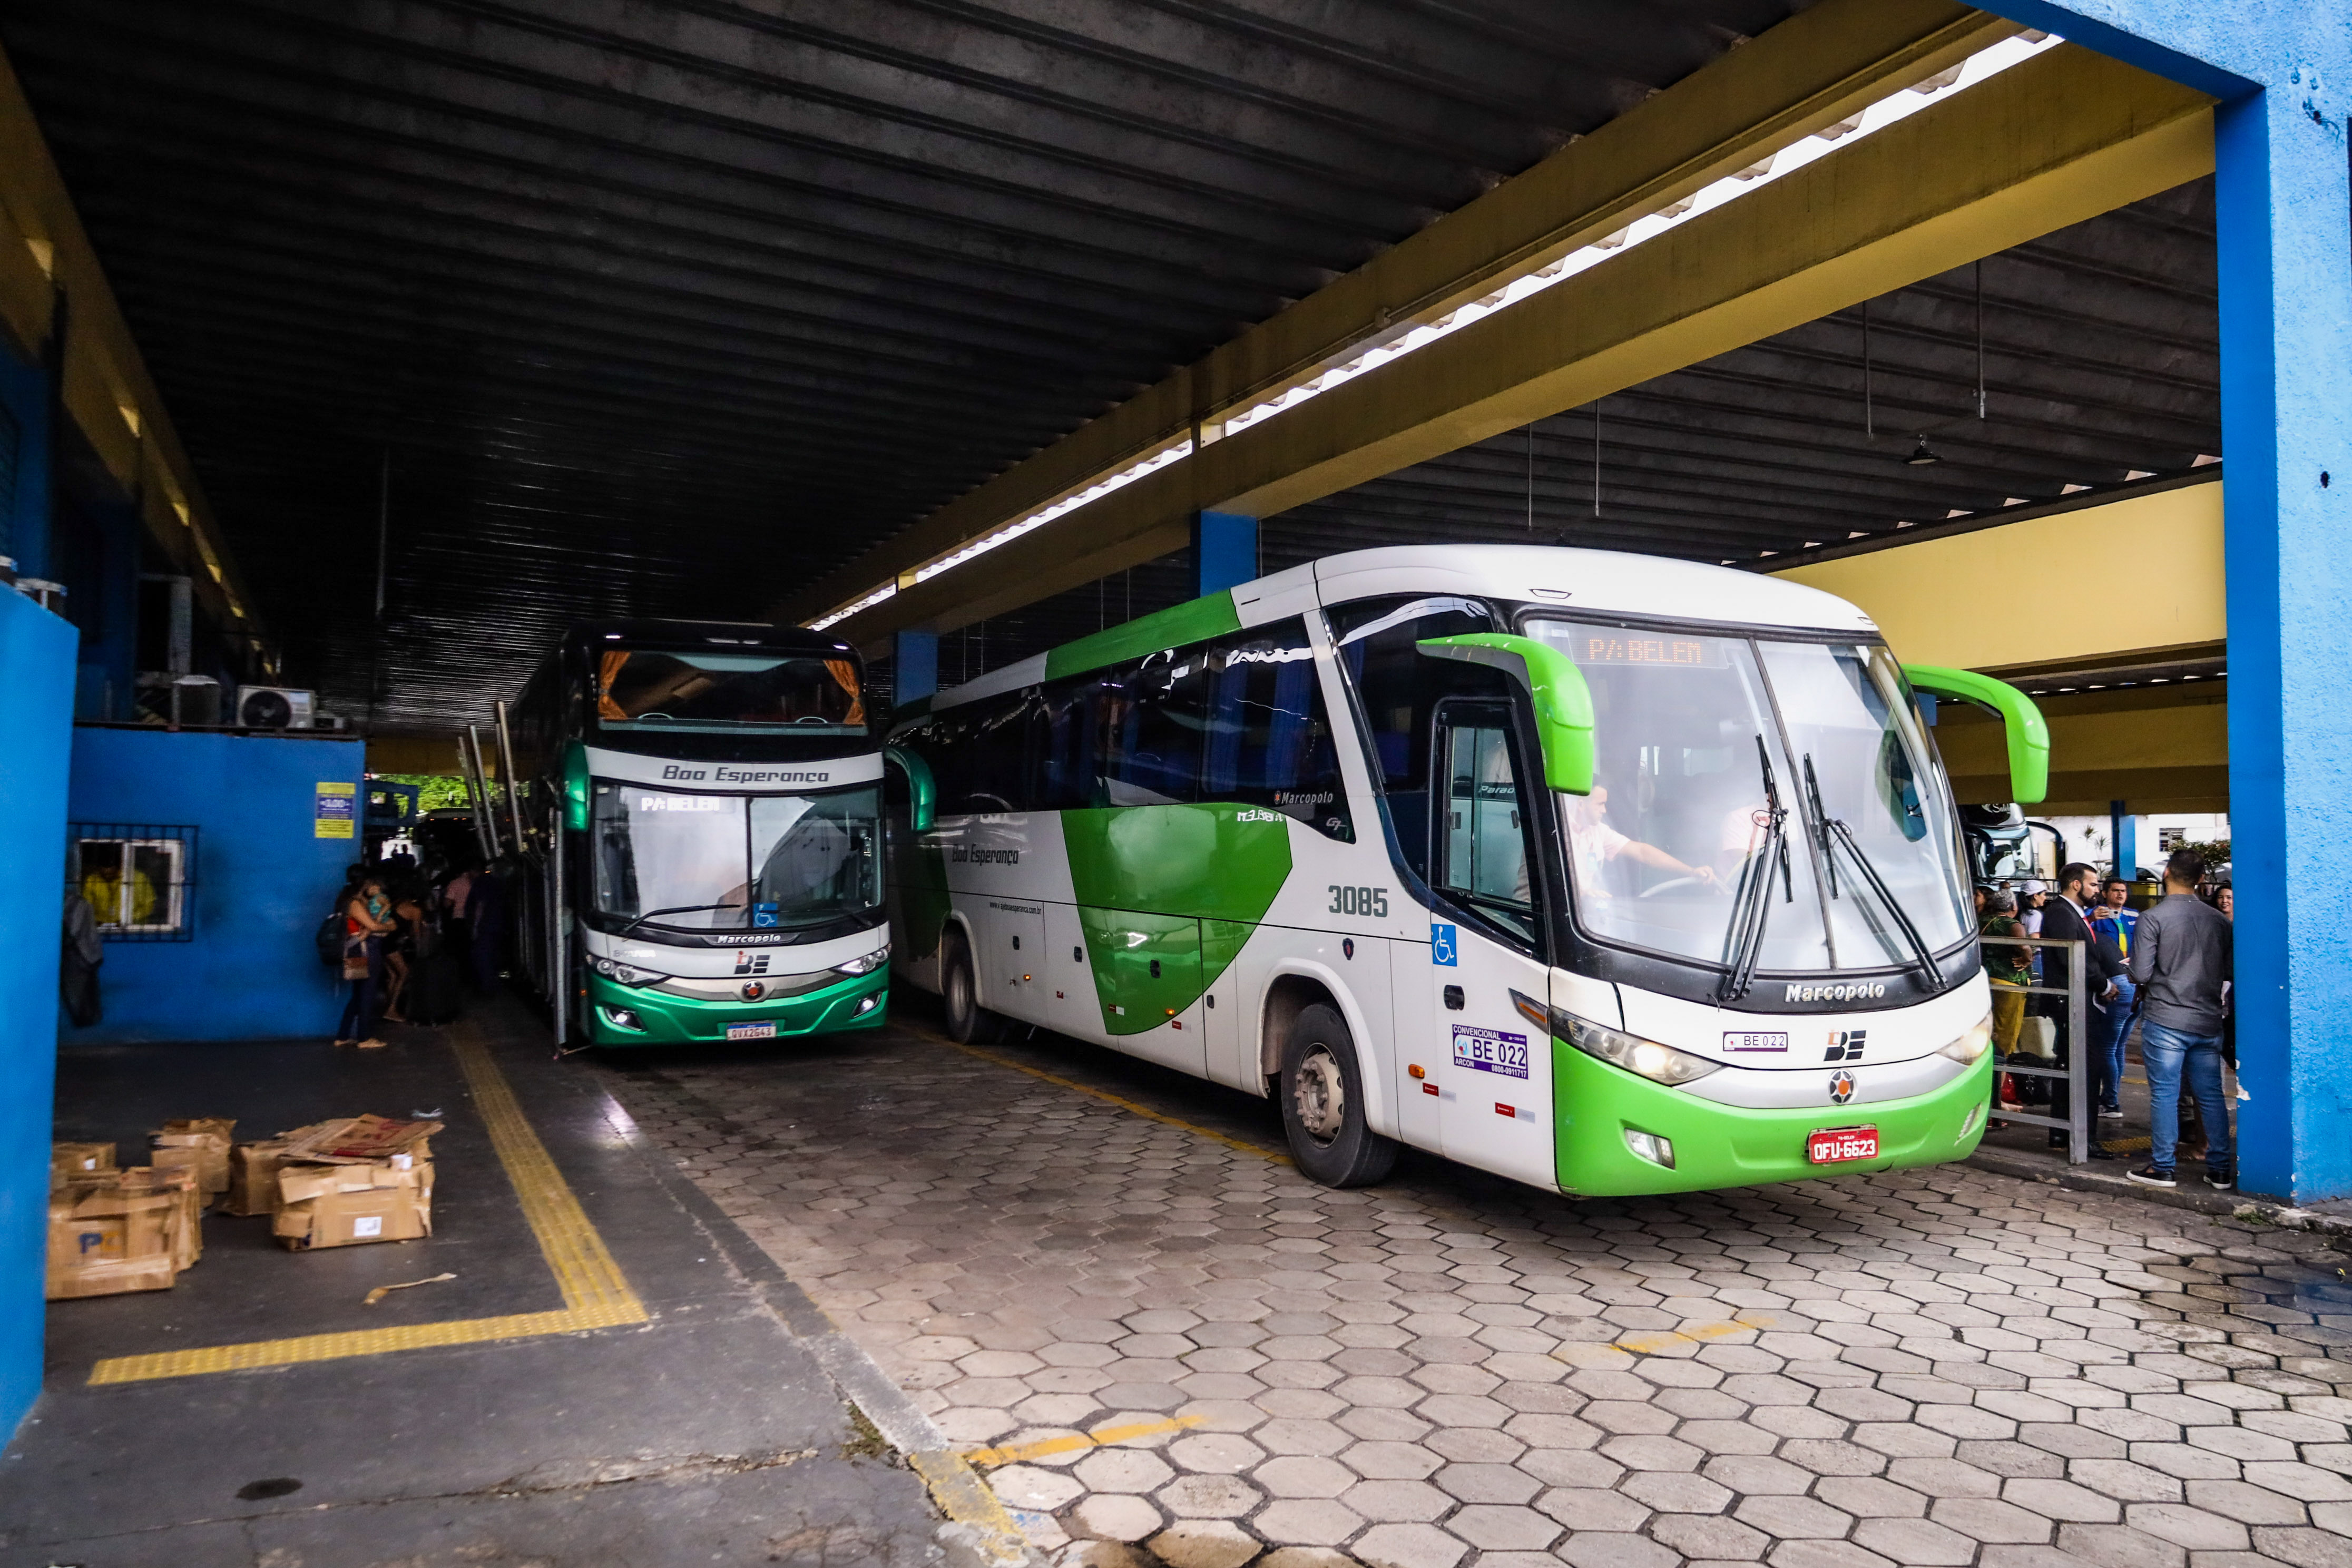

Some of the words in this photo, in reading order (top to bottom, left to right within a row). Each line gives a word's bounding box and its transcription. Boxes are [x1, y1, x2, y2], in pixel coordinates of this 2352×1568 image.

[662, 766, 707, 781] Boa
[715, 767, 829, 783] Esperança
[1281, 791, 1334, 805] Marcopolo
[971, 844, 1019, 866] Esperança
[1328, 885, 1388, 918] 3085
[717, 934, 781, 944] Marcopolo
[1785, 982, 1885, 1002] Marcopolo
[1453, 1025, 1501, 1040] CONVENCIONAL
[1473, 1038, 1493, 1061] BE
[1498, 1043, 1526, 1067] 022
[1455, 1057, 1475, 1068] ARCON
[1491, 1064, 1527, 1078] 0800-0911717
